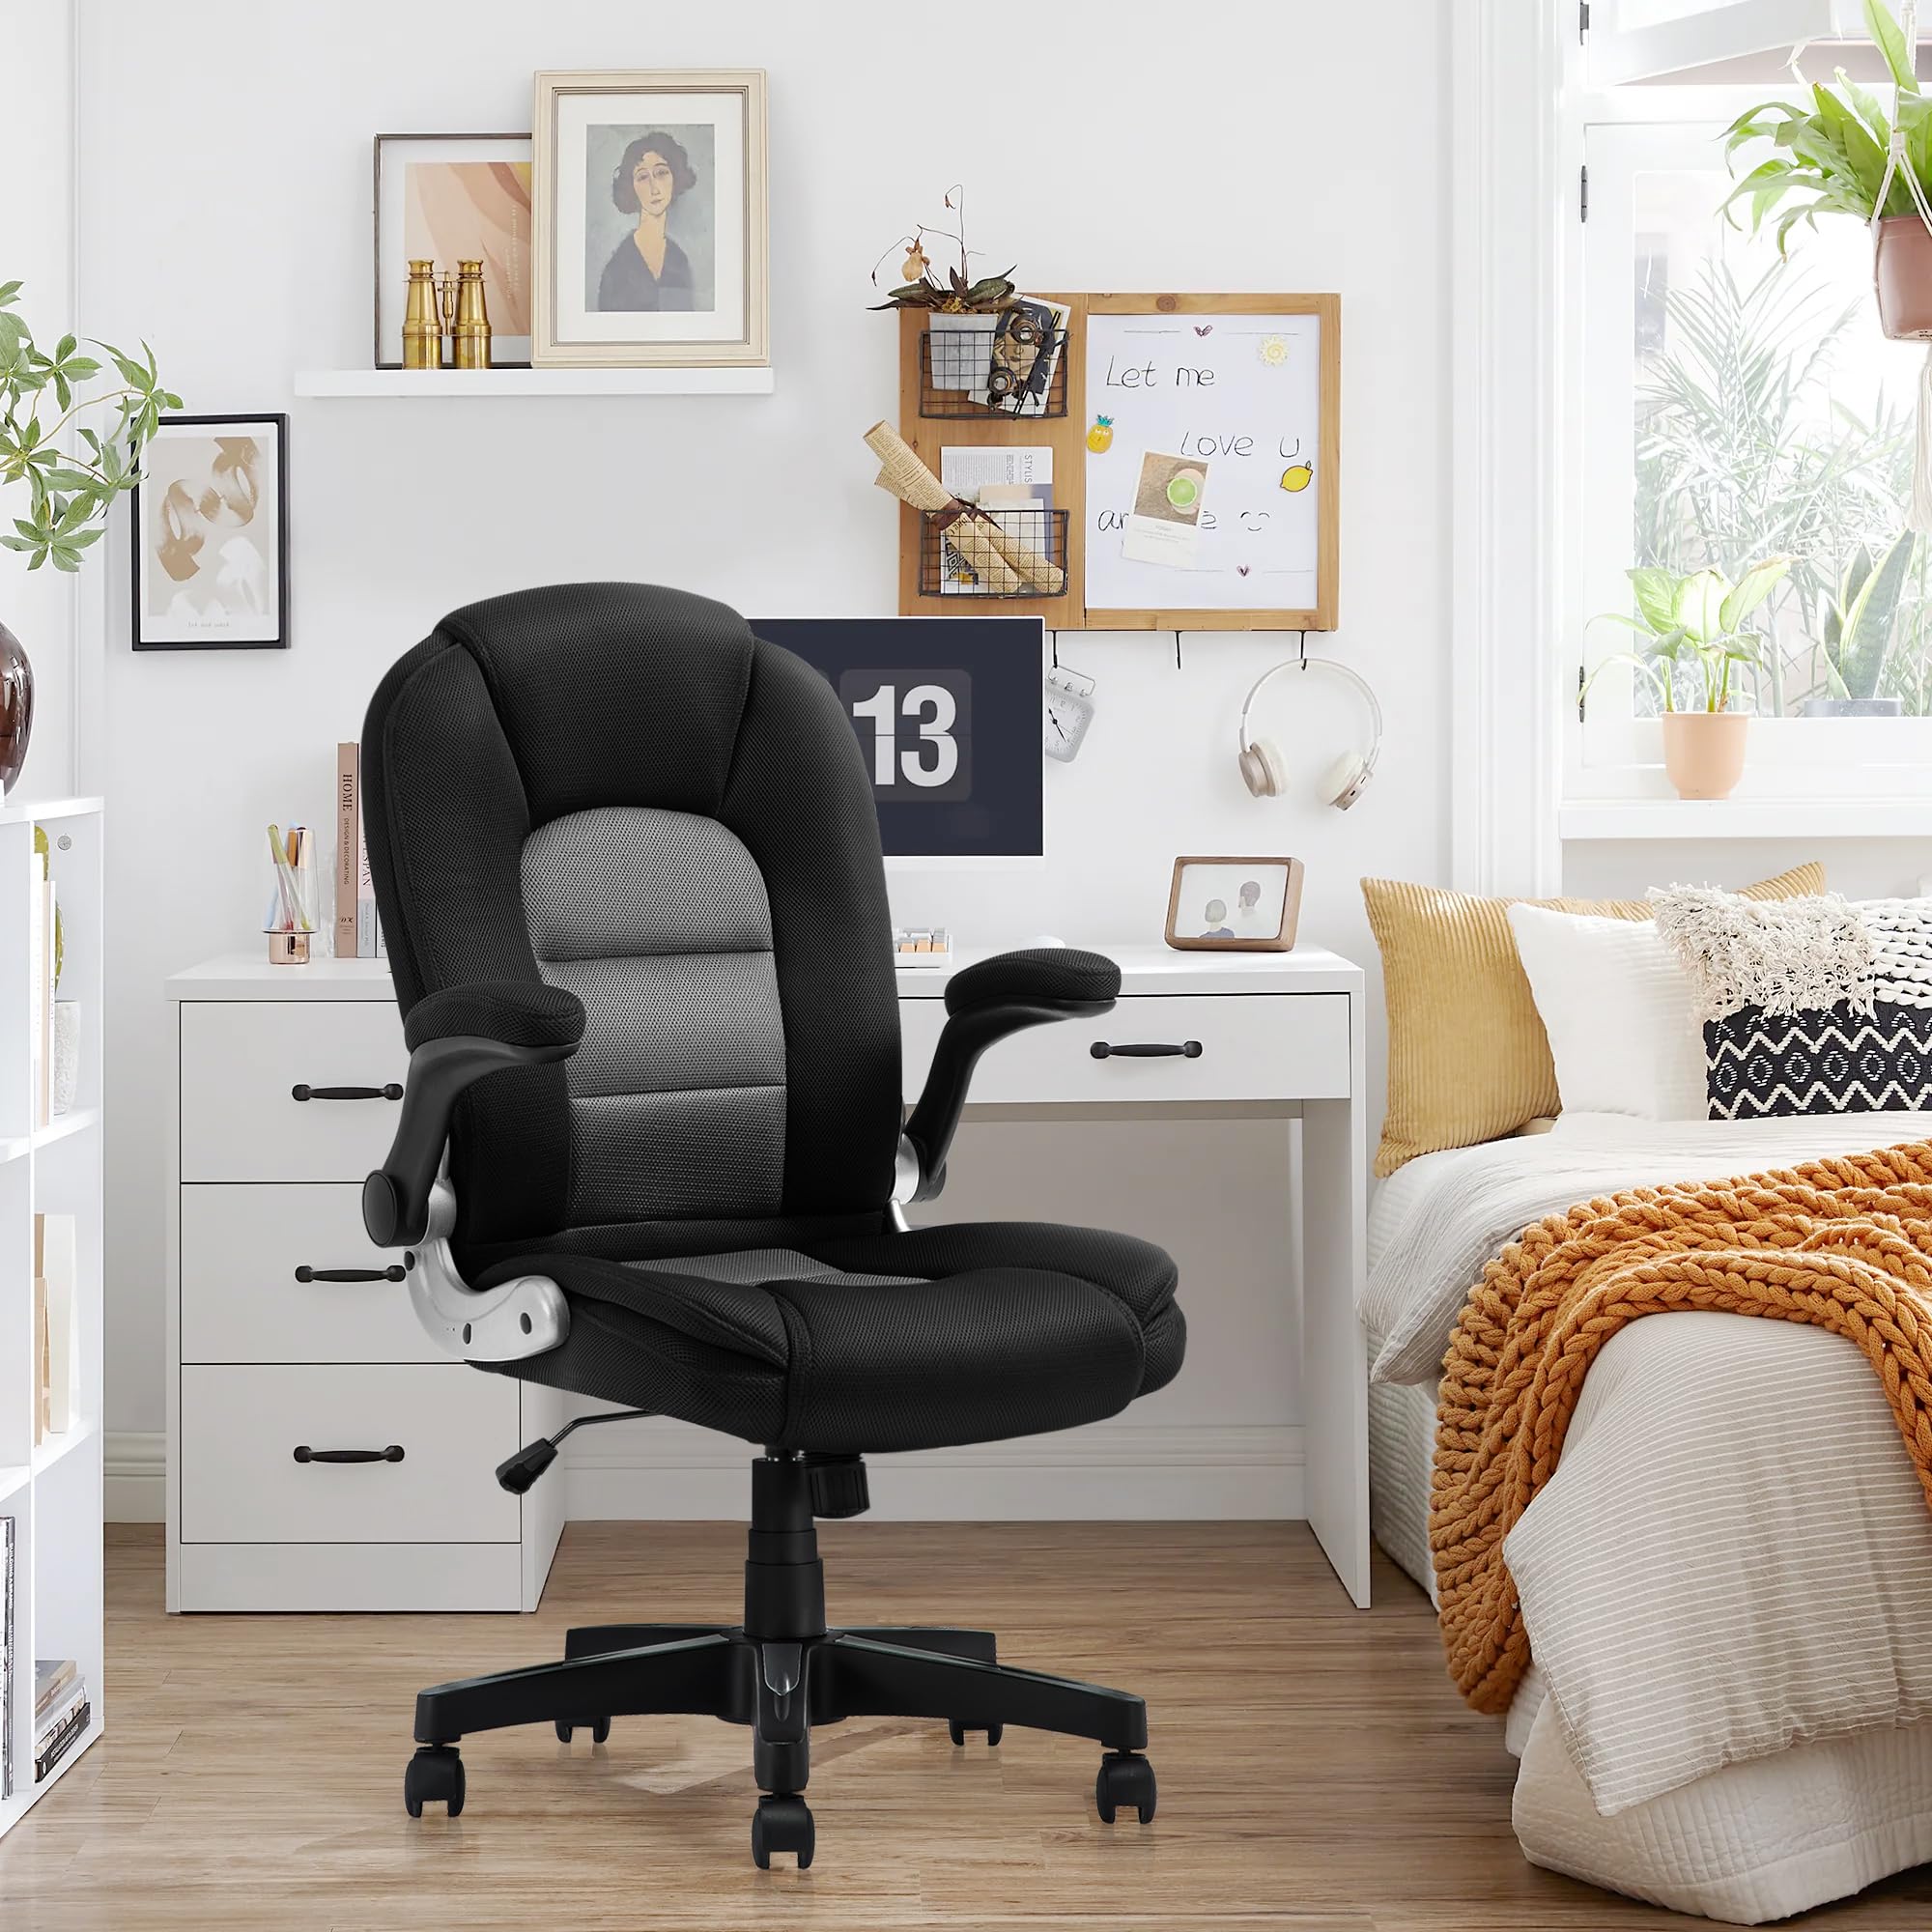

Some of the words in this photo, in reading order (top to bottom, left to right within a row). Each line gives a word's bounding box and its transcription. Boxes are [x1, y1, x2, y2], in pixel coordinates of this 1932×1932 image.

[1106, 355, 1157, 388] Let
[1176, 366, 1215, 387] me
[1180, 431, 1254, 457] Love
[852, 684, 958, 787] 13
[342, 774, 353, 811] HOME
